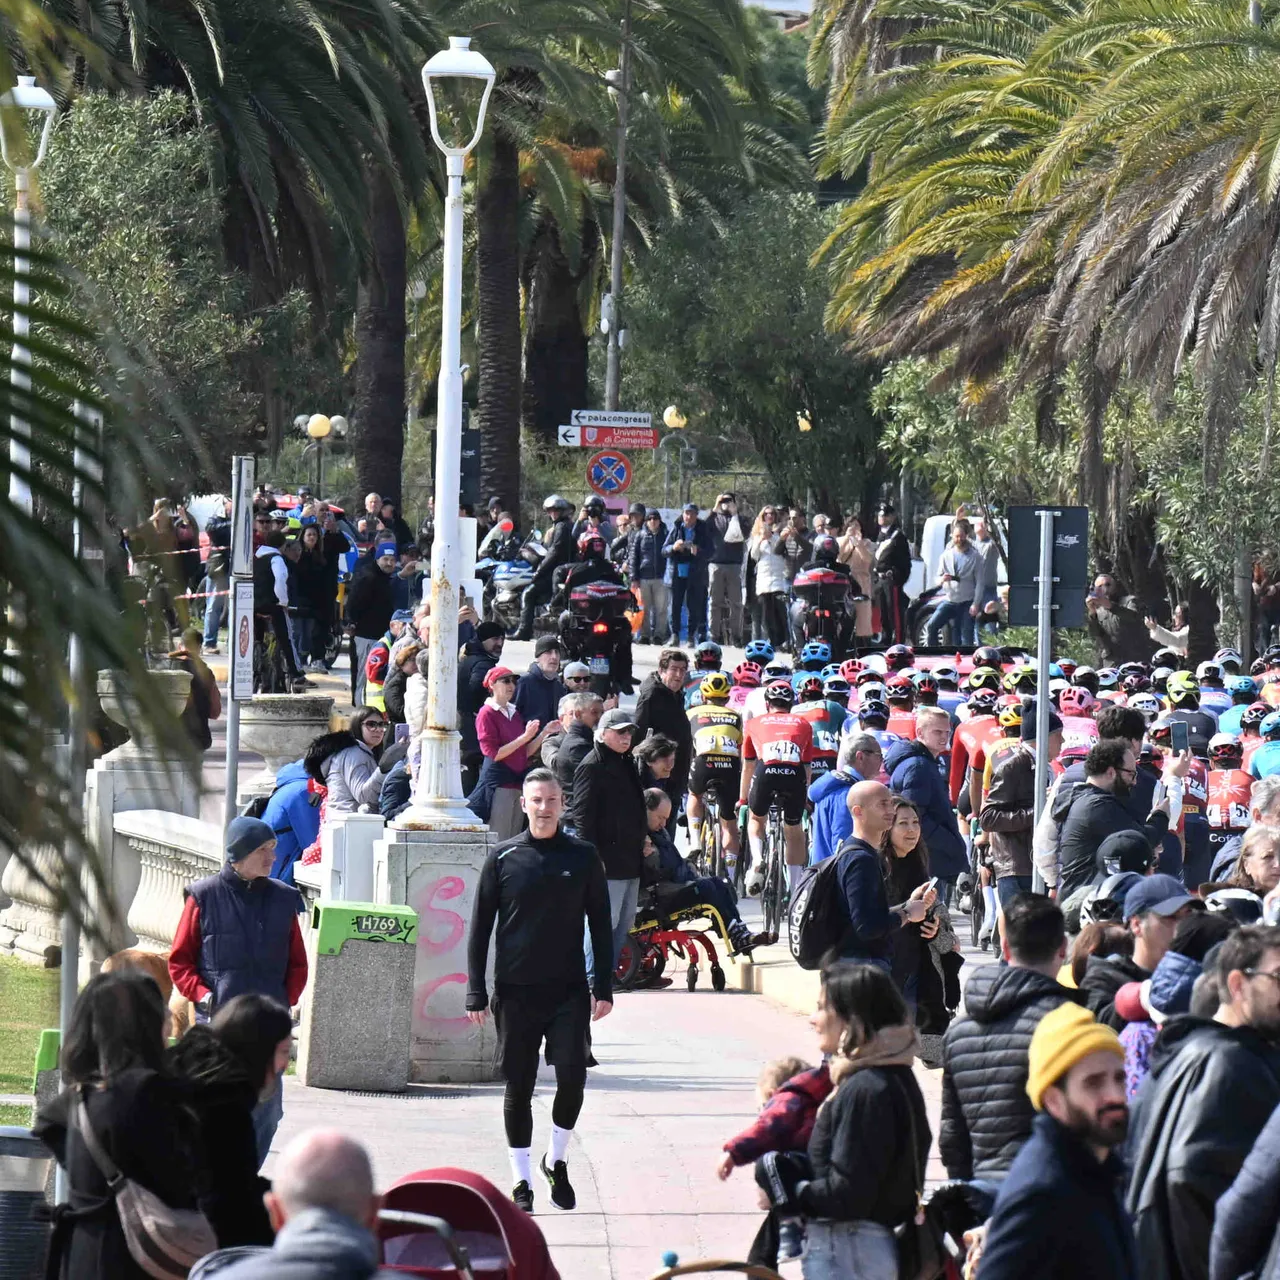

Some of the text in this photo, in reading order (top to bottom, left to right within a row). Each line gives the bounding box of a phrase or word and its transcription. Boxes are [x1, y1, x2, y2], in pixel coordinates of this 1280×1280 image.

[588, 415, 650, 424] palacongressi
[613, 427, 653, 437] Università
[613, 436, 653, 444] Camerino
[765, 768, 796, 776] ARKEA
[361, 917, 396, 931] H769
[790, 889, 808, 956] adidas
